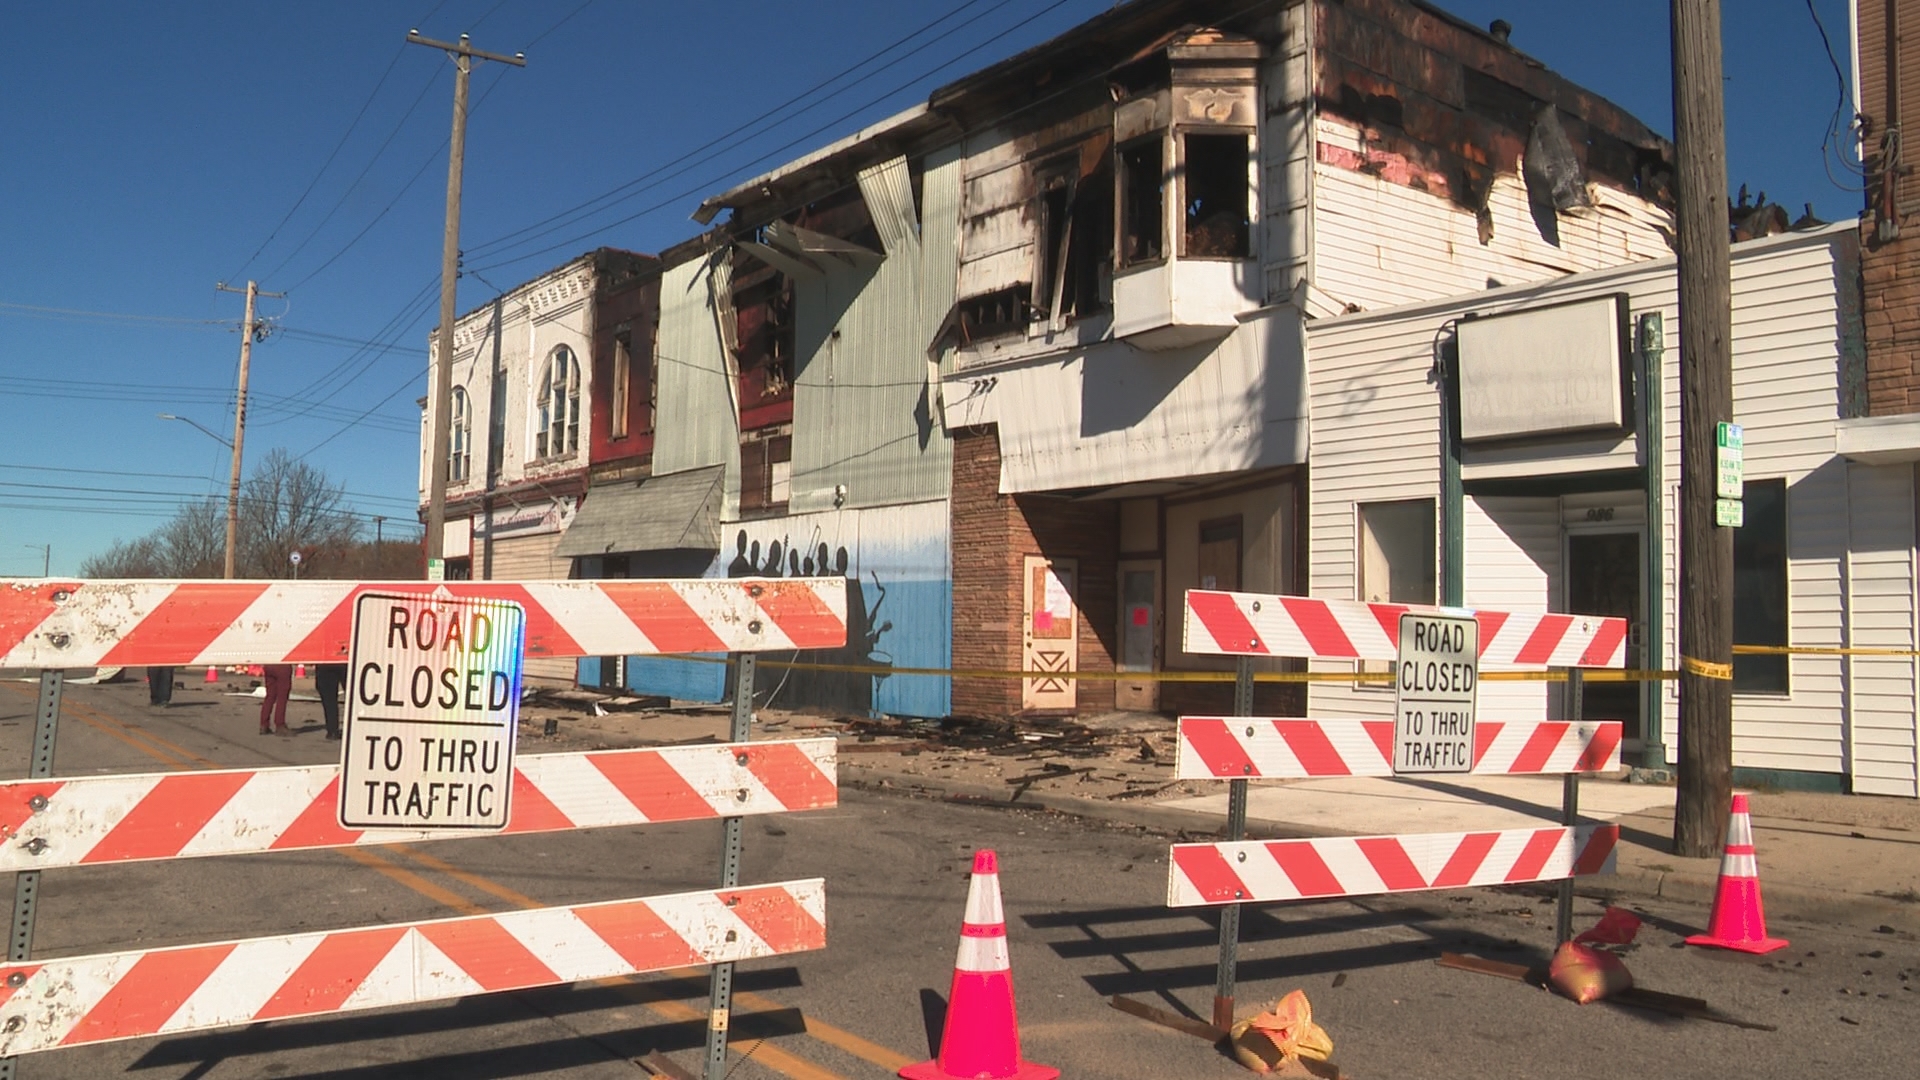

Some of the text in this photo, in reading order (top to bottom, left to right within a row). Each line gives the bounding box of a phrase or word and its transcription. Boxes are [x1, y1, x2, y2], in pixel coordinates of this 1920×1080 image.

[387, 606, 493, 653] ROAD
[1415, 621, 1464, 653] ROAD
[359, 662, 510, 711] CLOSED
[1402, 660, 1473, 692] CLOSED
[1405, 711, 1469, 736] TO THRU
[365, 735, 499, 774] TO THRU
[1404, 741, 1466, 767] TRAFFIC
[364, 780, 494, 818] TRAFFIC
